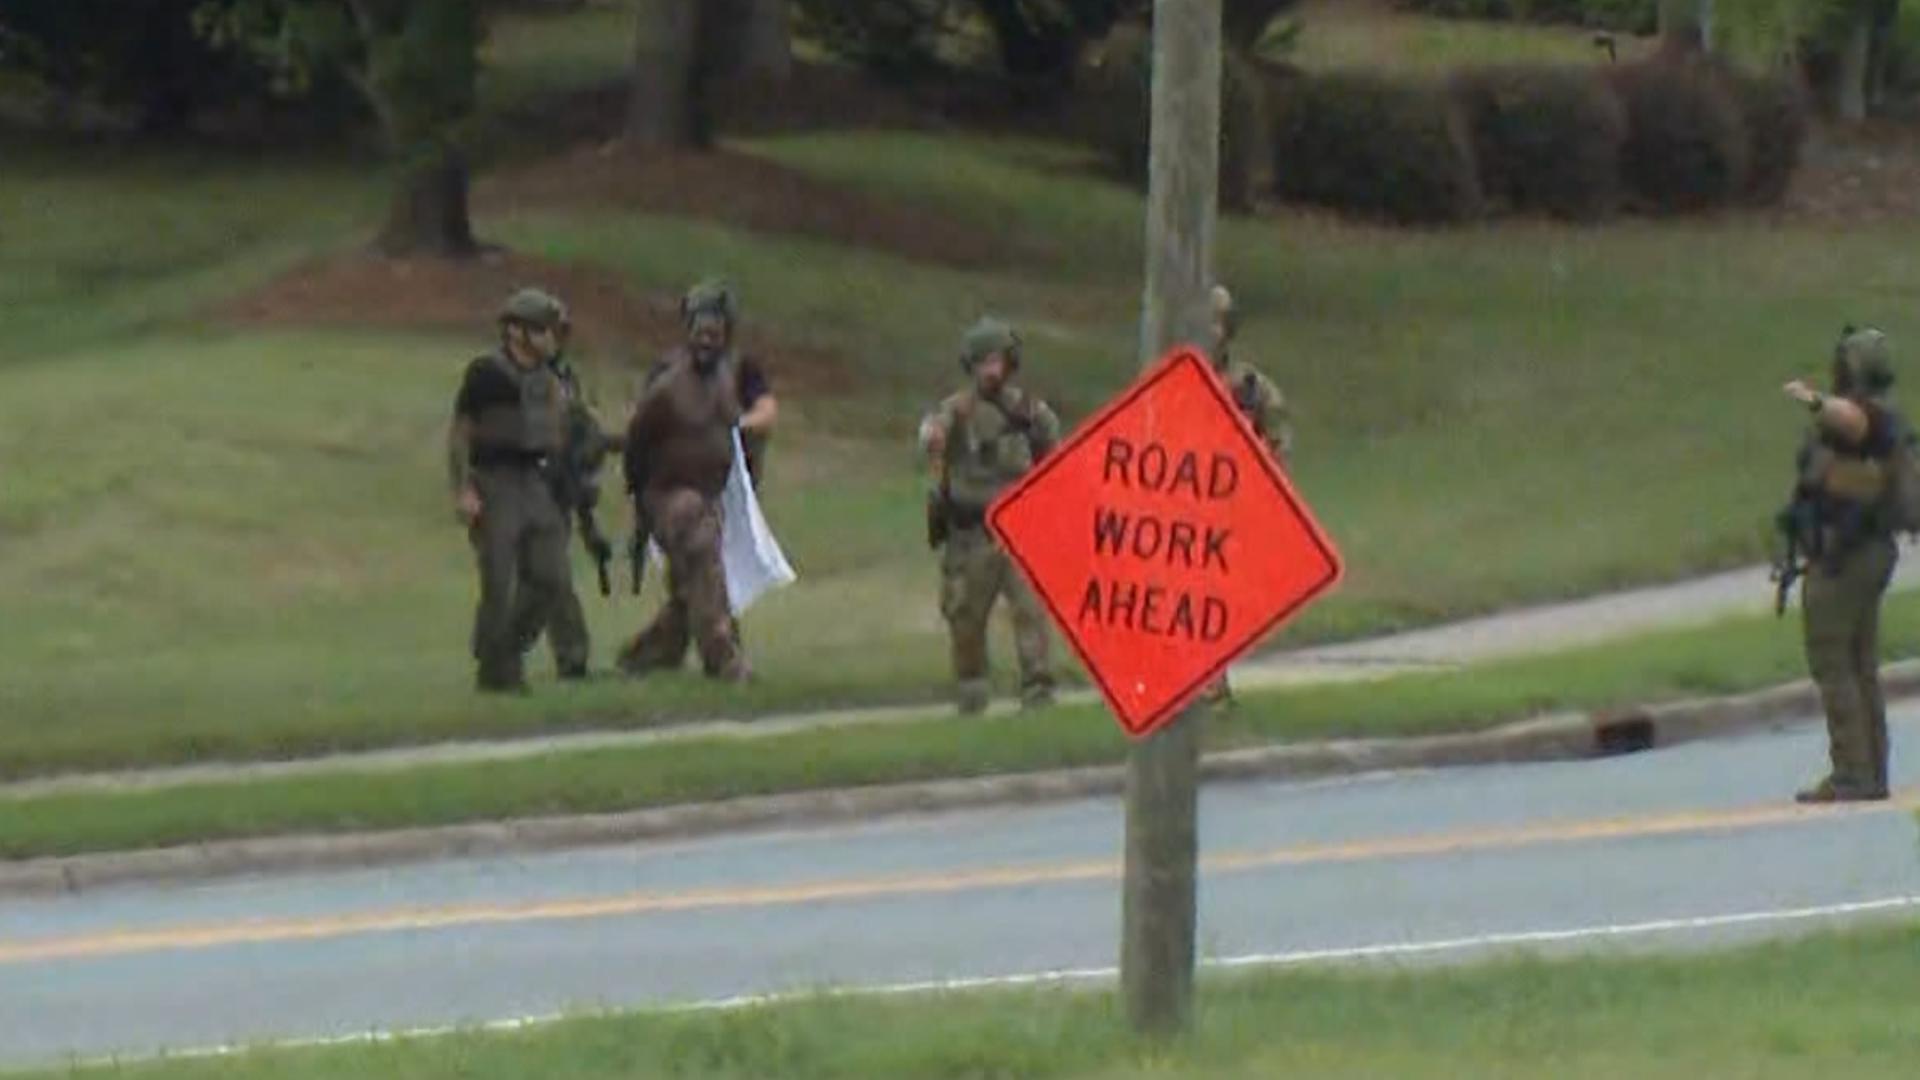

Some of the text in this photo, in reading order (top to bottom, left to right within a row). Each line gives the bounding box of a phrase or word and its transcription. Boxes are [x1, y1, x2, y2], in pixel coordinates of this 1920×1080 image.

[1103, 438, 1239, 498] ROAD
[1093, 509, 1233, 574] WORK
[1079, 580, 1228, 643] AHEAD
